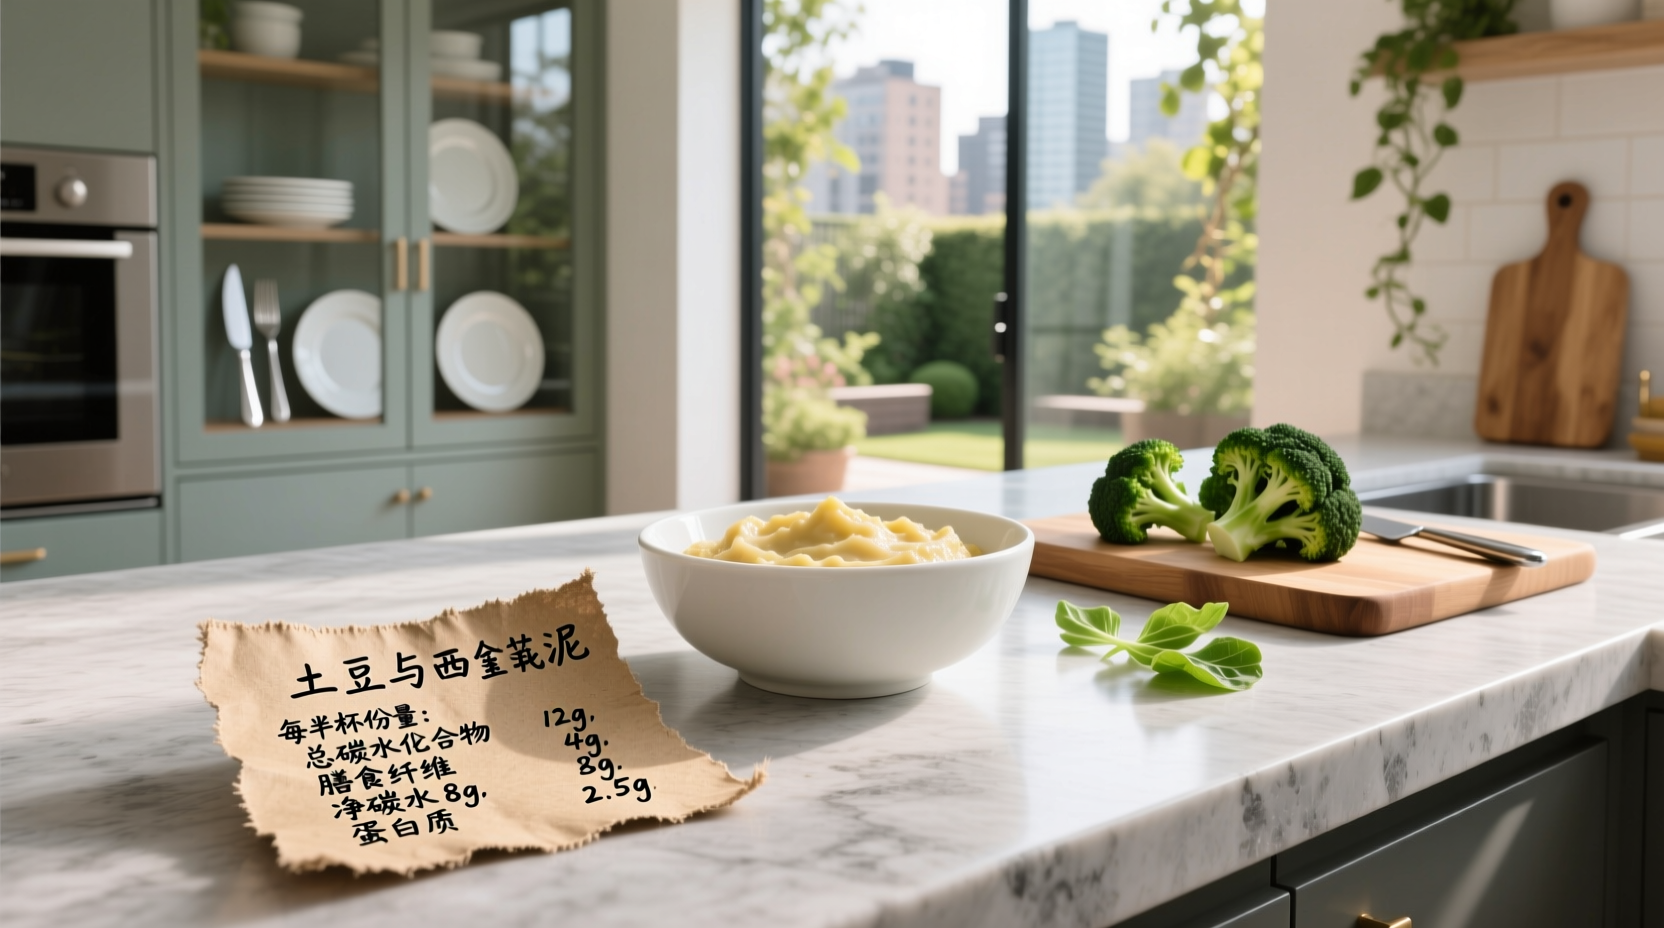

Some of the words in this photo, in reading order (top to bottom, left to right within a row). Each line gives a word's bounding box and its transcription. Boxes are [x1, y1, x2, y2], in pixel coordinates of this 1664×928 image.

[306, 720, 490, 769] 总碳水化合物
[543, 707, 595, 732] 12g.
[318, 756, 457, 796] 膳食纤维
[564, 732, 609, 758] 4g.
[331, 788, 439, 821] 净碳水
[443, 783, 487, 808] 8g.
[576, 755, 622, 781] 8g.
[352, 809, 459, 846] 蛋白质
